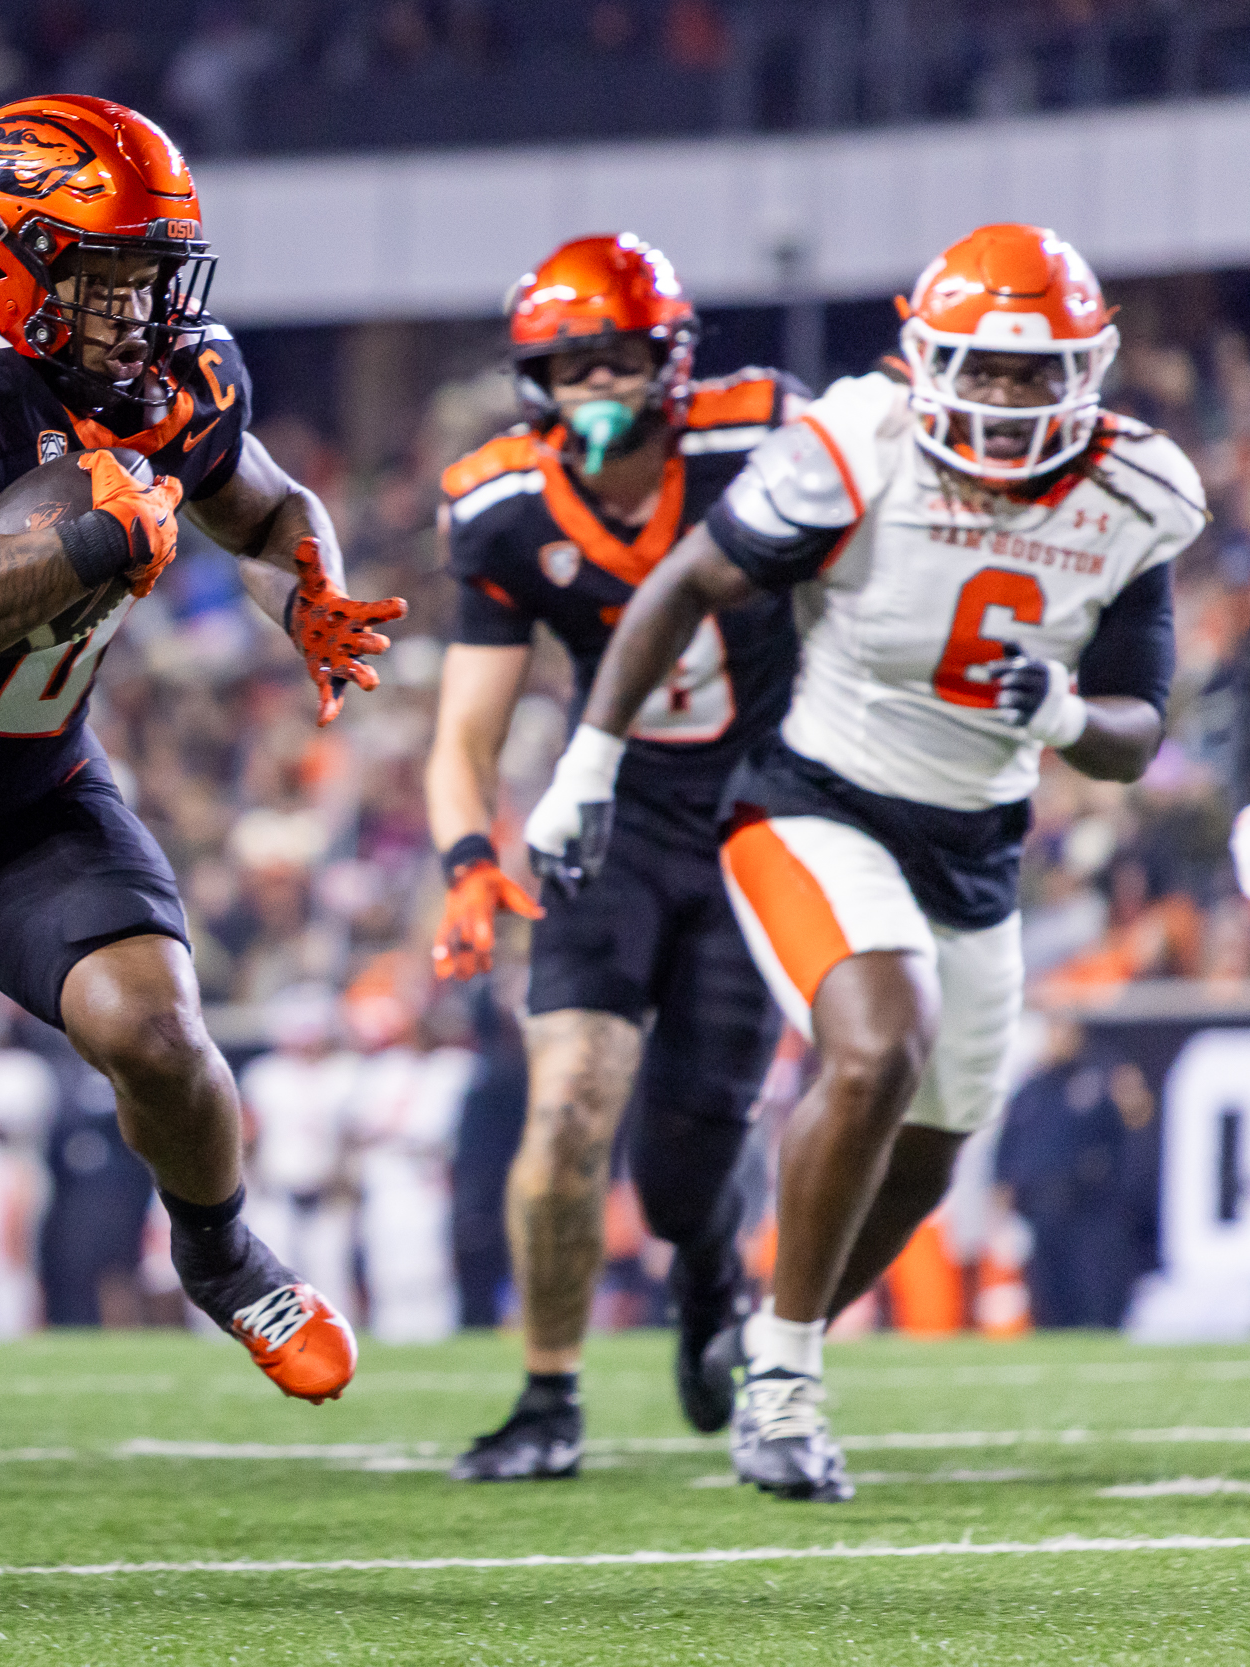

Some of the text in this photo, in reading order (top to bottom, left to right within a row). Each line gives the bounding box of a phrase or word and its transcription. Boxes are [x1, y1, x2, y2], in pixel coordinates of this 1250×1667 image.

[167, 220, 195, 239] OSU
[198, 348, 236, 411] C
[932, 565, 1049, 711] 6
